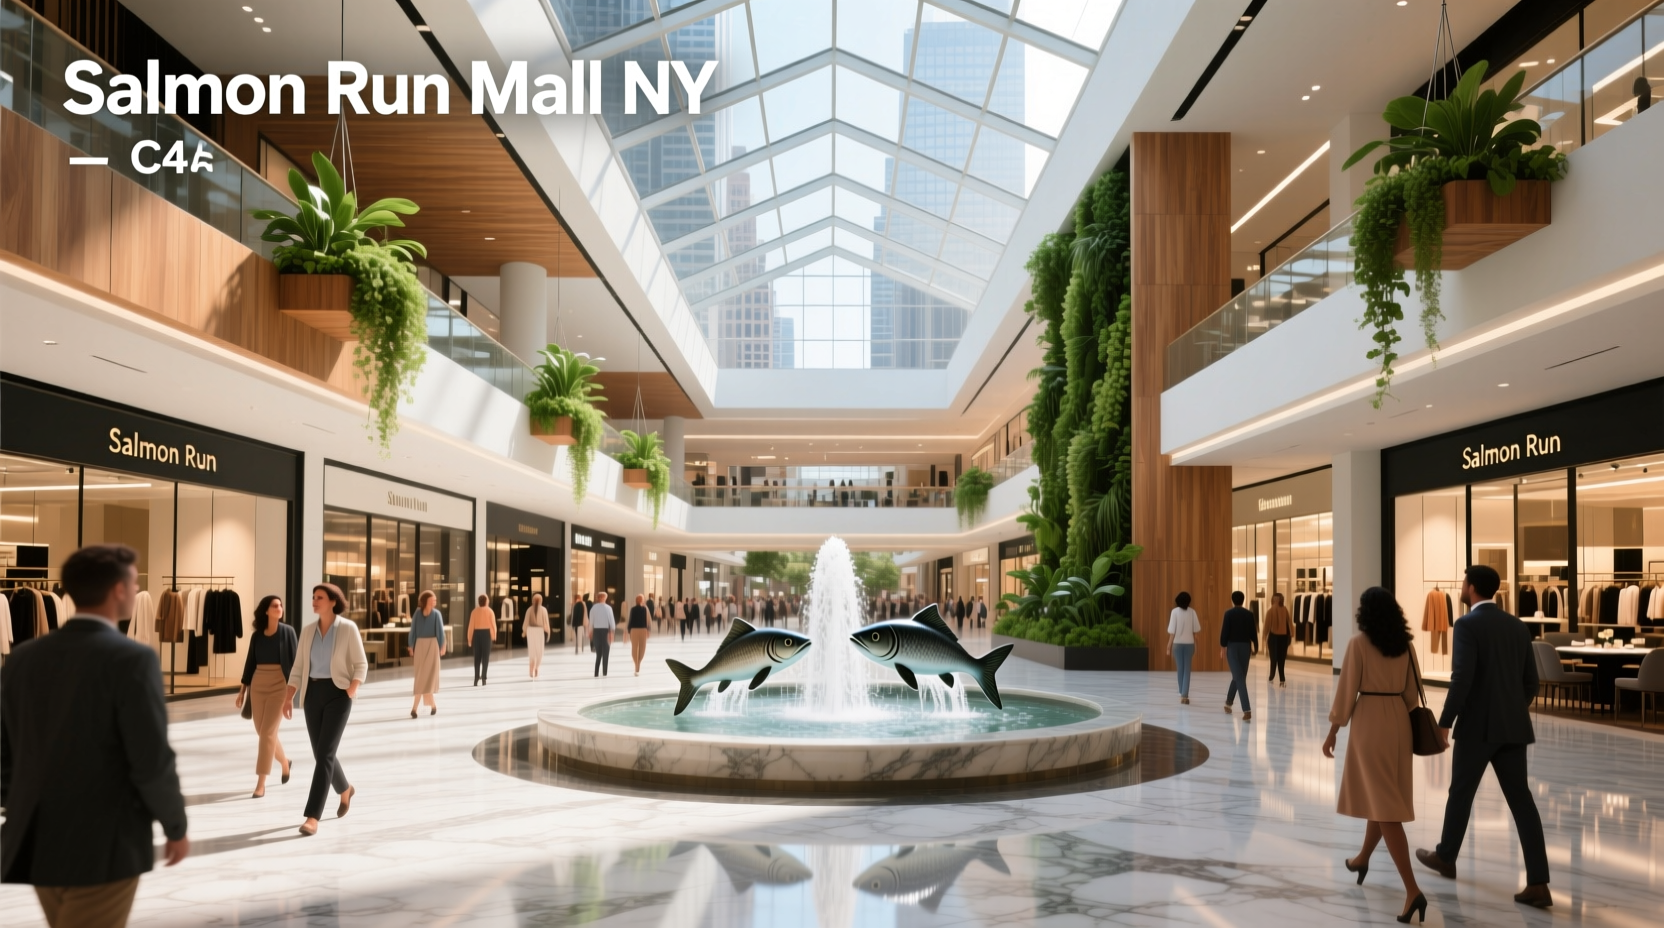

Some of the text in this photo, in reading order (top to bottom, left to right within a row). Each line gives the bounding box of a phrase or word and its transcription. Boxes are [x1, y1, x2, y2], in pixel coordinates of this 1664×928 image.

[108, 427, 217, 473] Salmon Run
[1462, 433, 1561, 470] Salmon Run
